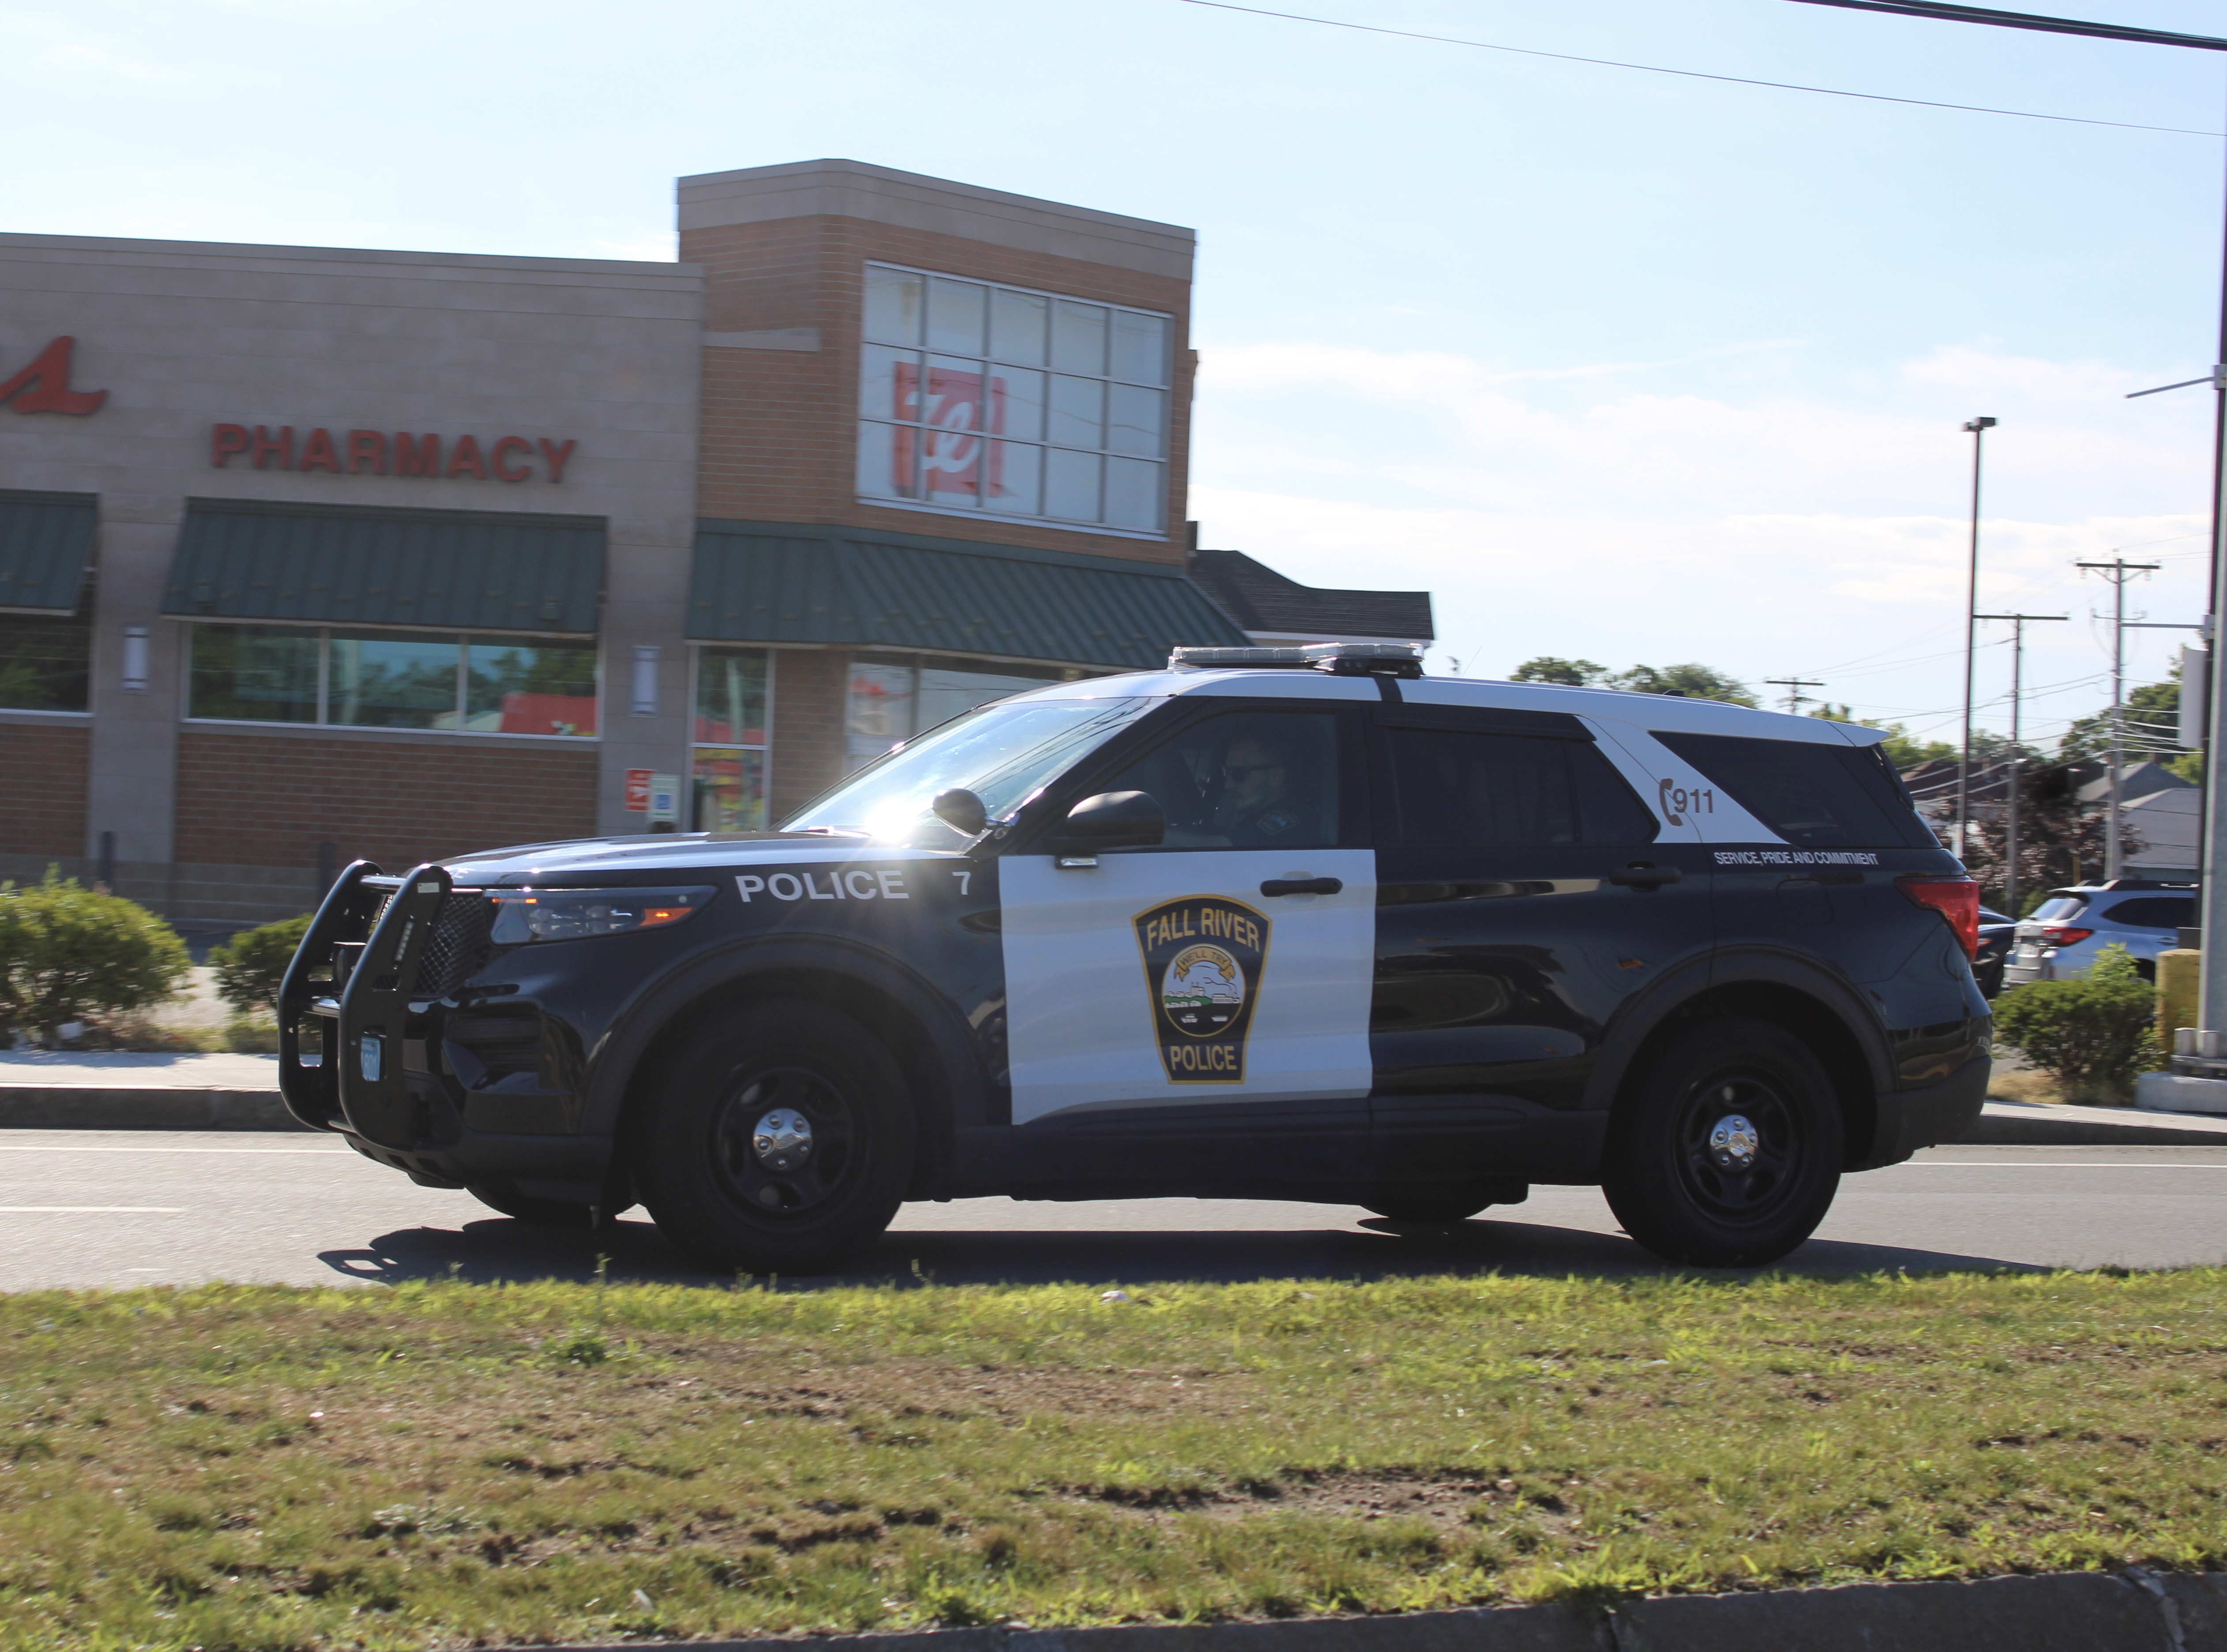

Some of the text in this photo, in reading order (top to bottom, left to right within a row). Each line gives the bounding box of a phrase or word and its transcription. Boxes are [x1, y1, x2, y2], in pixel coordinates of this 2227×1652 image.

[211, 423, 577, 484] PHARMACY
[1673, 788, 1713, 814] 911
[1714, 852, 1879, 866] SERVICE, PRIDE AND COMMITMENT
[735, 871, 971, 902] POLICE 7
[1147, 908, 1260, 953] FALL RIVER
[1180, 950, 1228, 965] WE'LL TRY
[1170, 1045, 1238, 1071] POLICE
